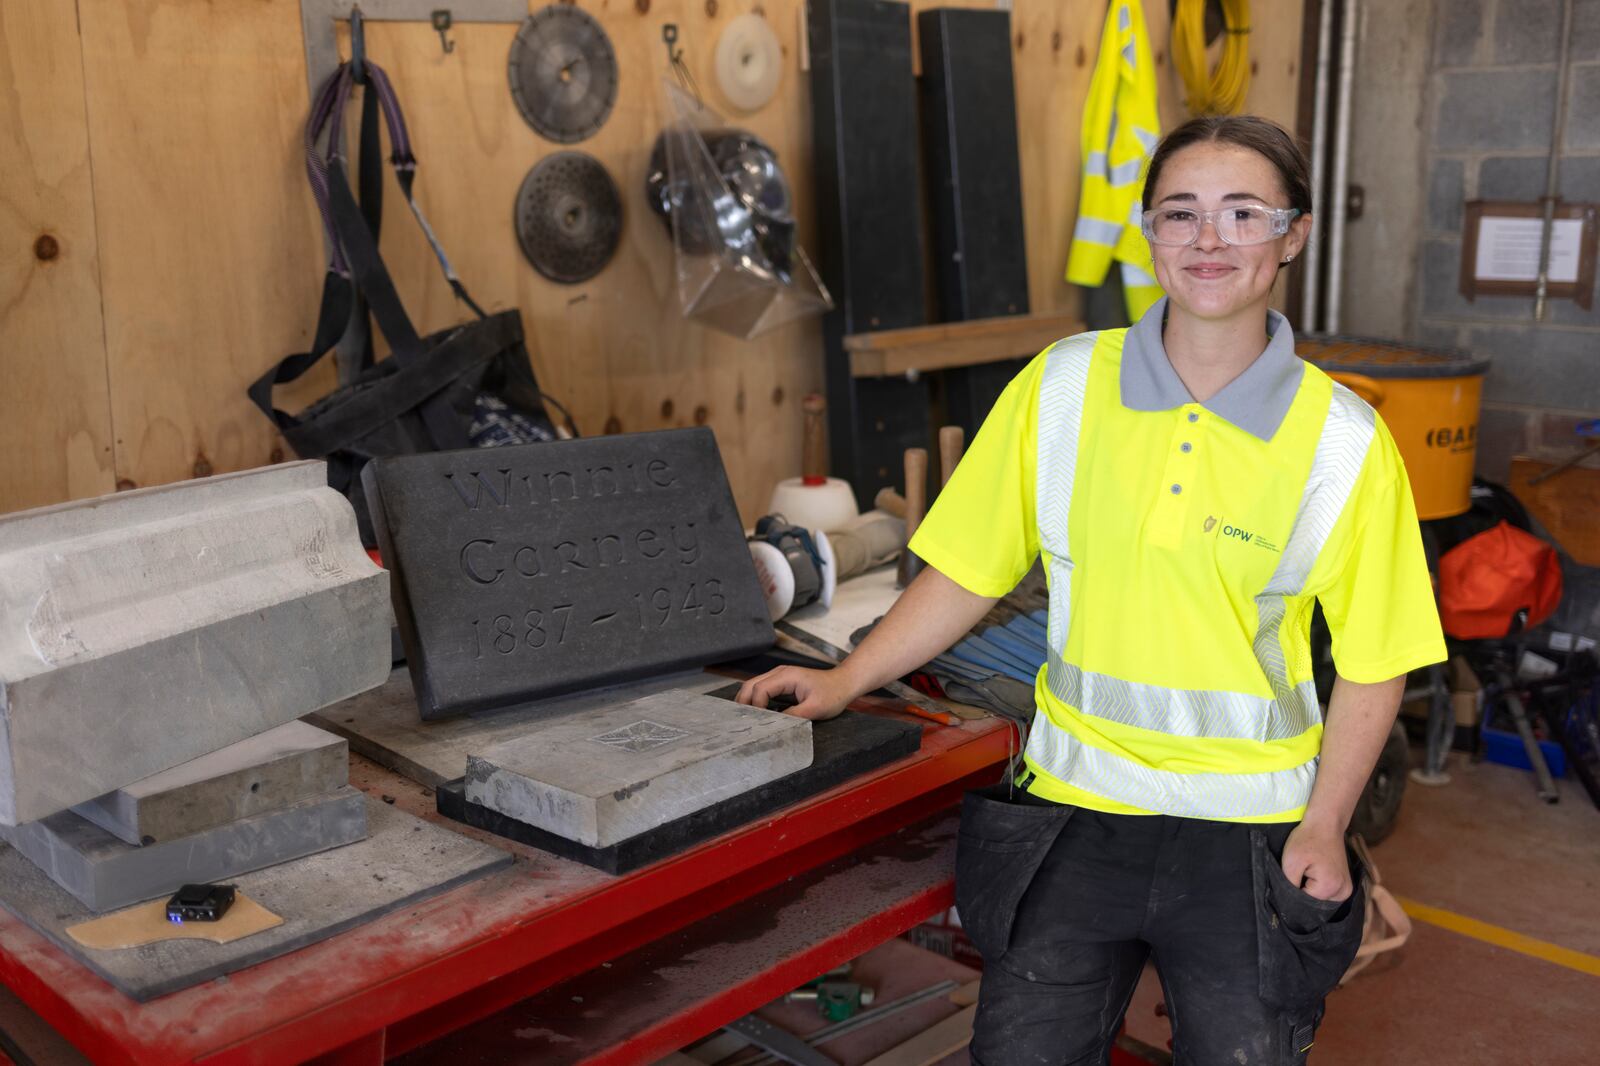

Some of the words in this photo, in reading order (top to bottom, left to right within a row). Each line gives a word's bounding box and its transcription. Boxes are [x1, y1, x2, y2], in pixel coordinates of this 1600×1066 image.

[444, 459, 678, 510] Winnie
[1223, 525, 1253, 542] OPW
[471, 603, 574, 659] 1887
[633, 578, 727, 630] 1943
